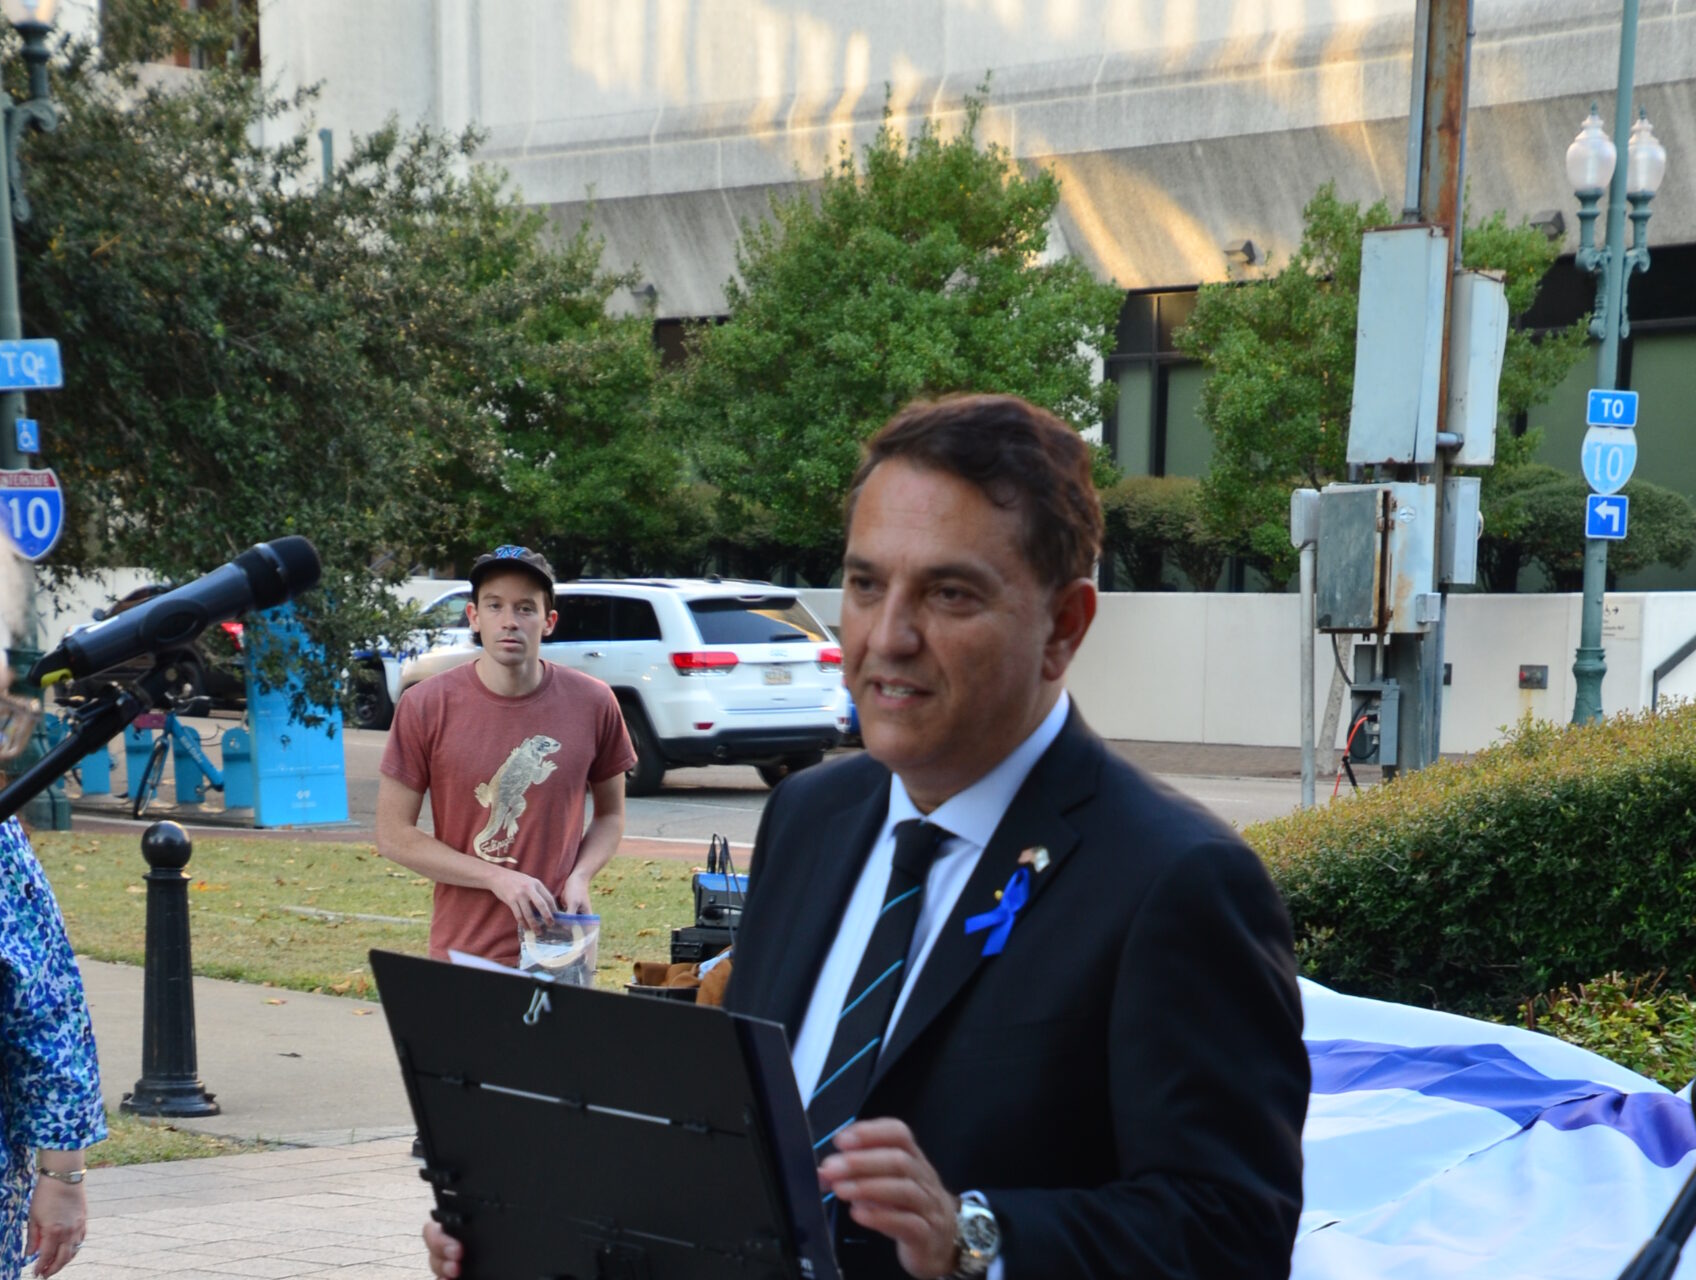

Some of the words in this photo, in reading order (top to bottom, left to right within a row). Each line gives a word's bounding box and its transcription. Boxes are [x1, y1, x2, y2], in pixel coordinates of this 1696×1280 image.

[1601, 398, 1624, 418] TO
[1593, 445, 1623, 482] 10
[8, 497, 51, 539] 10
